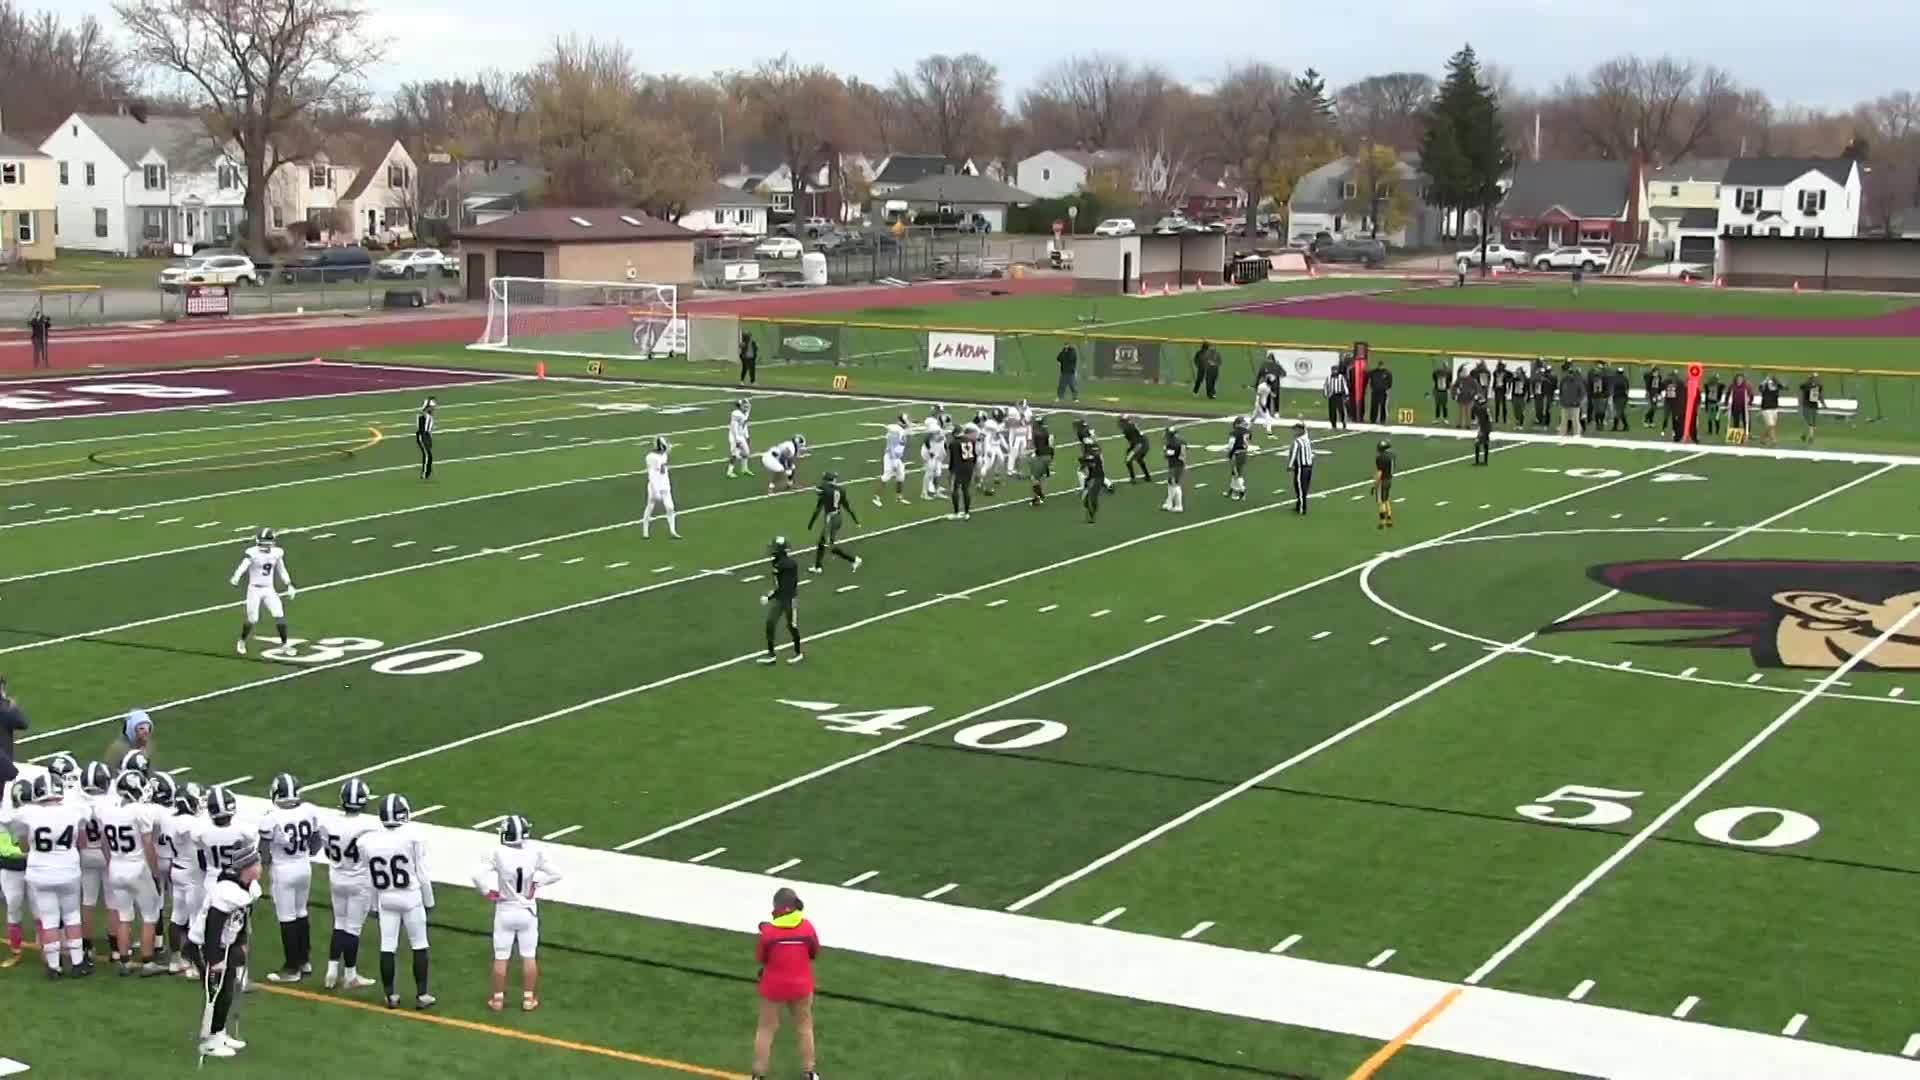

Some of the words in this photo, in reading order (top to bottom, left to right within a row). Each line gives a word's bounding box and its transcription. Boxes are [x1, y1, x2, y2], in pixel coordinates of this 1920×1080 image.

[933, 342, 952, 358] LA
[955, 342, 990, 361] NOVA
[261, 562, 274, 578] 9
[816, 704, 1069, 750] 40
[1515, 783, 1821, 849] 50
[34, 824, 75, 853] 64
[104, 824, 137, 854] 85
[283, 819, 313, 856] 38
[325, 834, 360, 865] 54
[211, 843, 233, 869] 15
[369, 854, 412, 891] 66
[514, 865, 524, 894] 1
